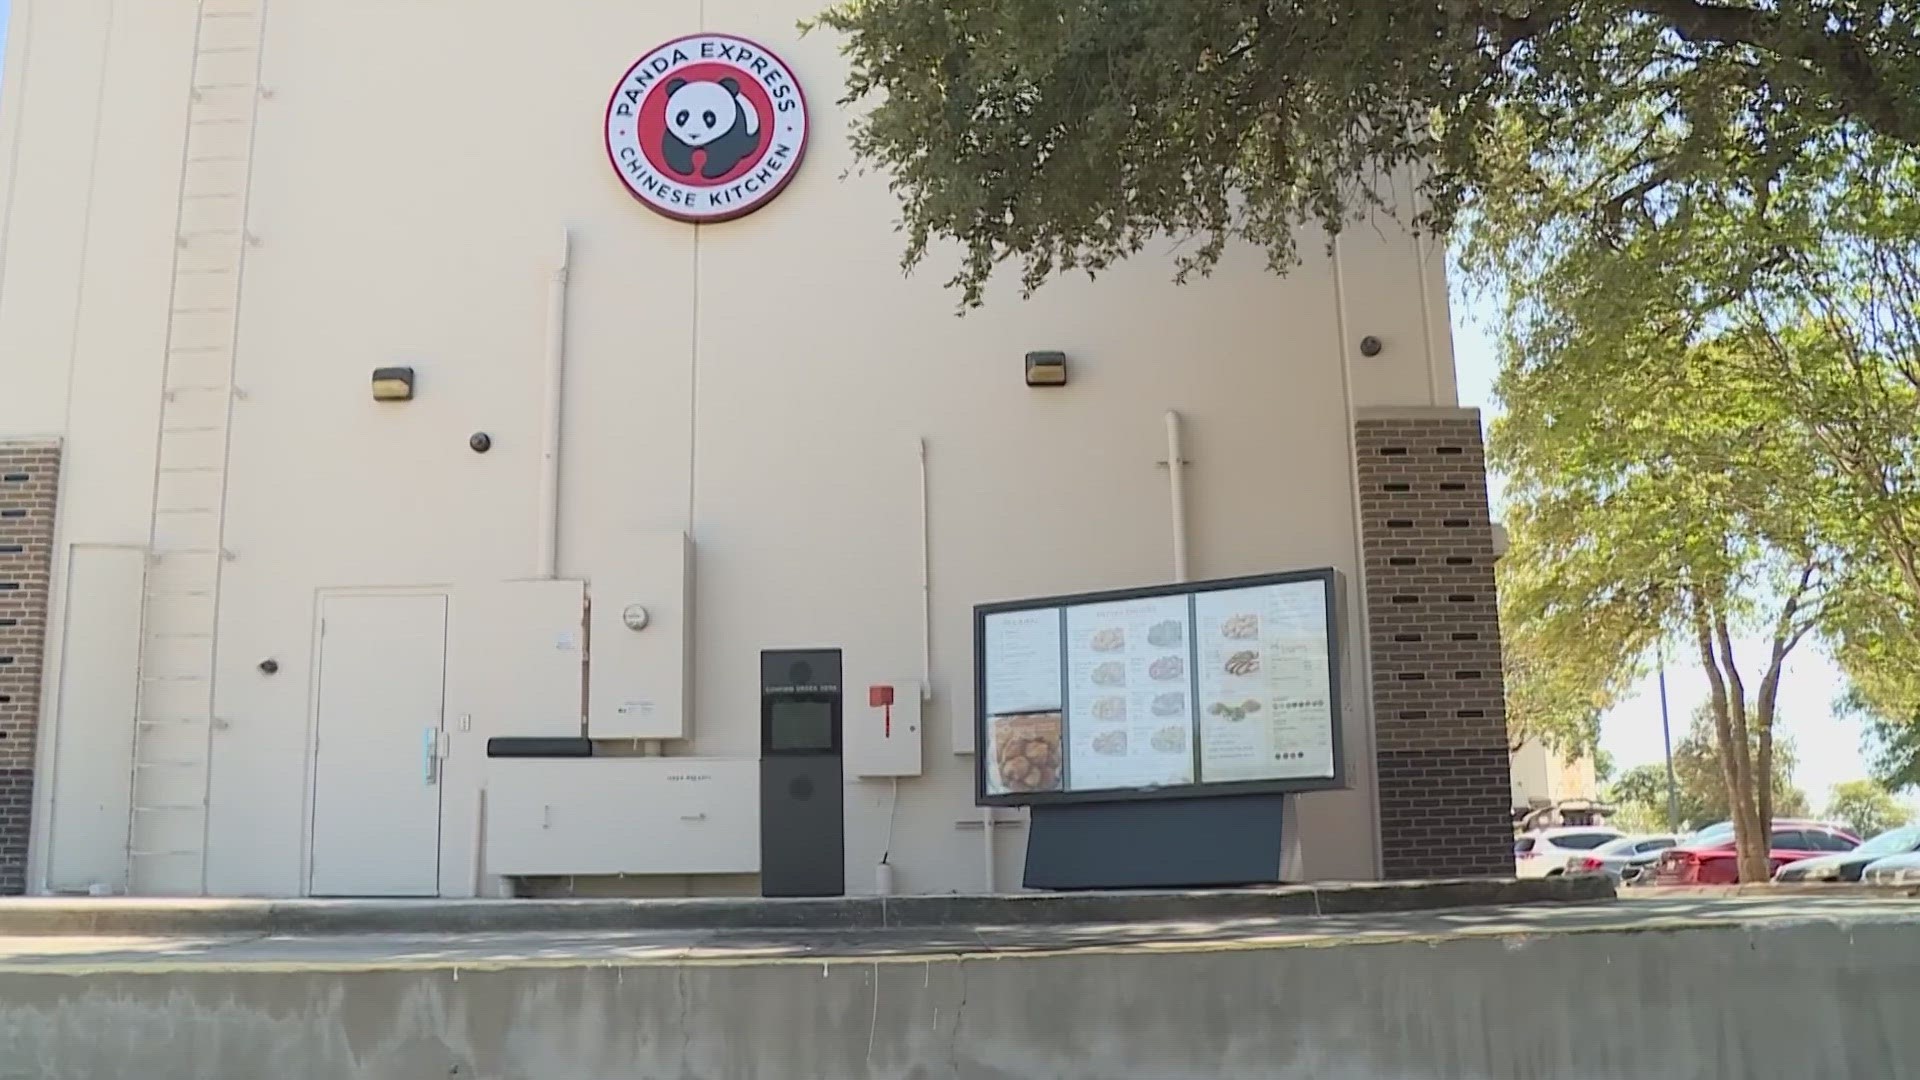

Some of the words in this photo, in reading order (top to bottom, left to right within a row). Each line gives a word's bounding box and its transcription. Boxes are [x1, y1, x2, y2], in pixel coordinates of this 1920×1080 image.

[616, 48, 689, 118] PANDA
[700, 41, 796, 113] EXPRESS
[620, 146, 696, 207] CHINESE
[709, 143, 791, 207] KITCHEN
